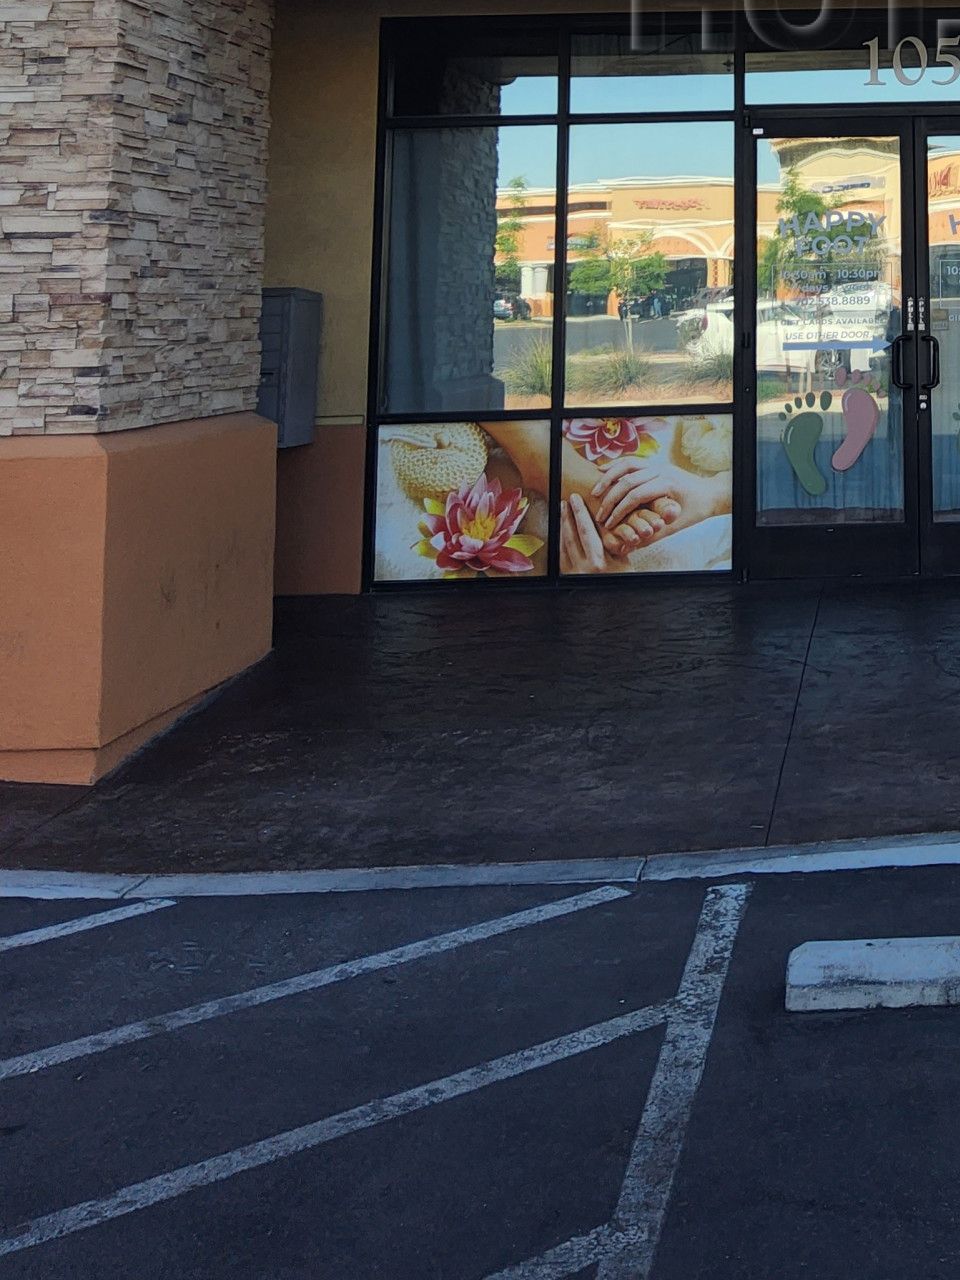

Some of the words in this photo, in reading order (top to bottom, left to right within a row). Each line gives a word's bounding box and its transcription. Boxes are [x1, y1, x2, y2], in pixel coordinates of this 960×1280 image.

[778, 209, 887, 238] HAPPY
[795, 234, 869, 257] FOOT
[785, 332, 804, 340] USE
[806, 331, 839, 340] OTHER
